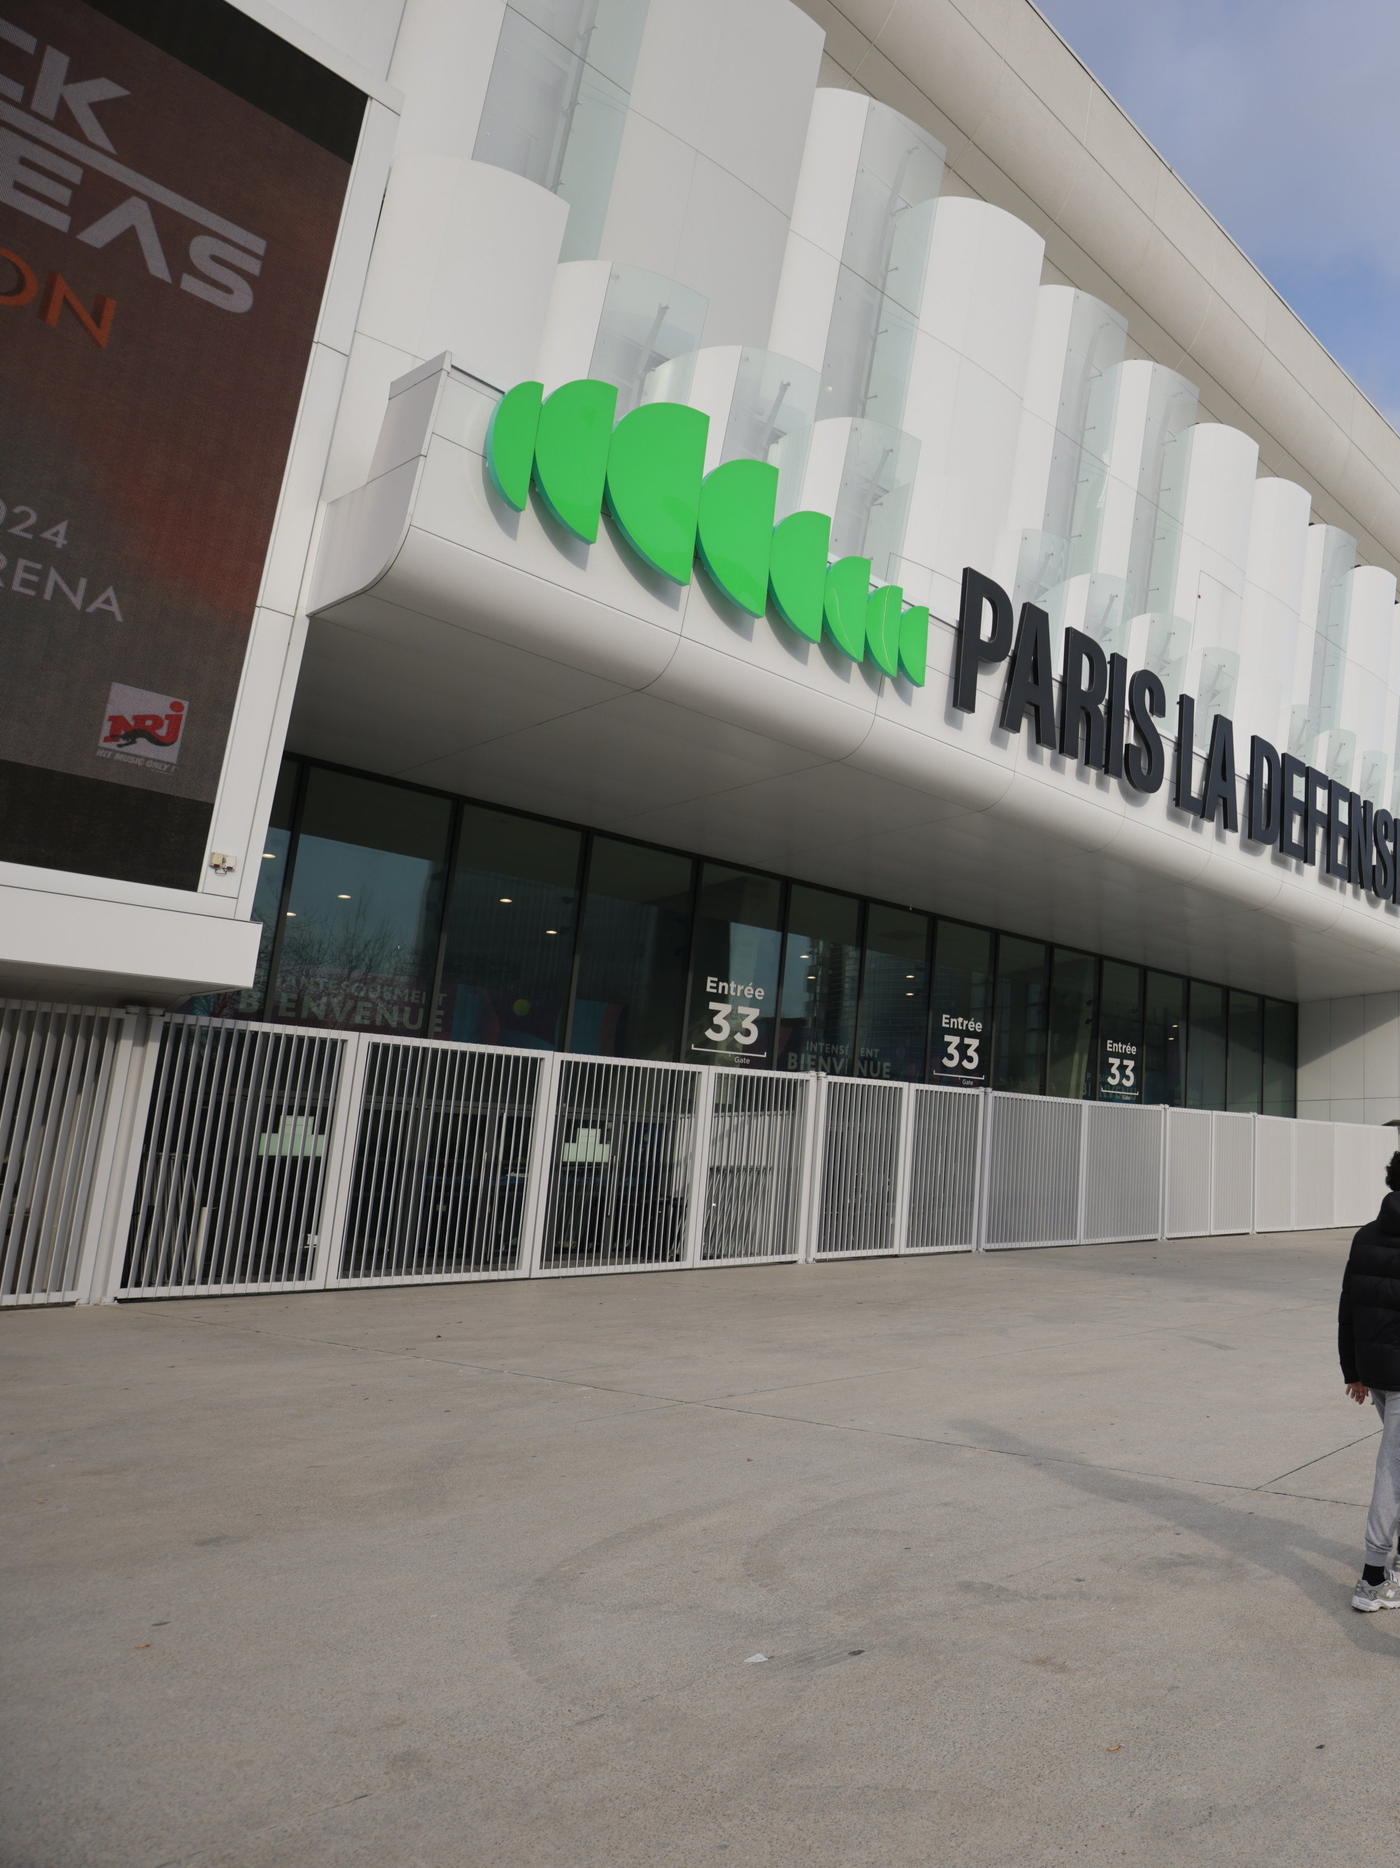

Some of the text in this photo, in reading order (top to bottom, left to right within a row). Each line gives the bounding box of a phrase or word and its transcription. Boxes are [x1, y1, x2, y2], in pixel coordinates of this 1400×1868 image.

[0, 499, 69, 549] 24
[0, 552, 123, 622] ENA
[953, 567, 1166, 794] PARIS
[1175, 693, 1238, 833] LA
[103, 701, 185, 747] NRJ
[705, 976, 765, 1000] Entrée
[238, 989, 445, 1033] BENVENUE
[704, 1001, 761, 1045] 33
[941, 1014, 983, 1033] Entrée
[734, 1056, 751, 1065] Gate
[787, 1052, 891, 1078] BIENVNUE
[941, 1035, 980, 1070] 33
[1106, 1040, 1137, 1055] Entrée
[1106, 1057, 1135, 1087] 33
